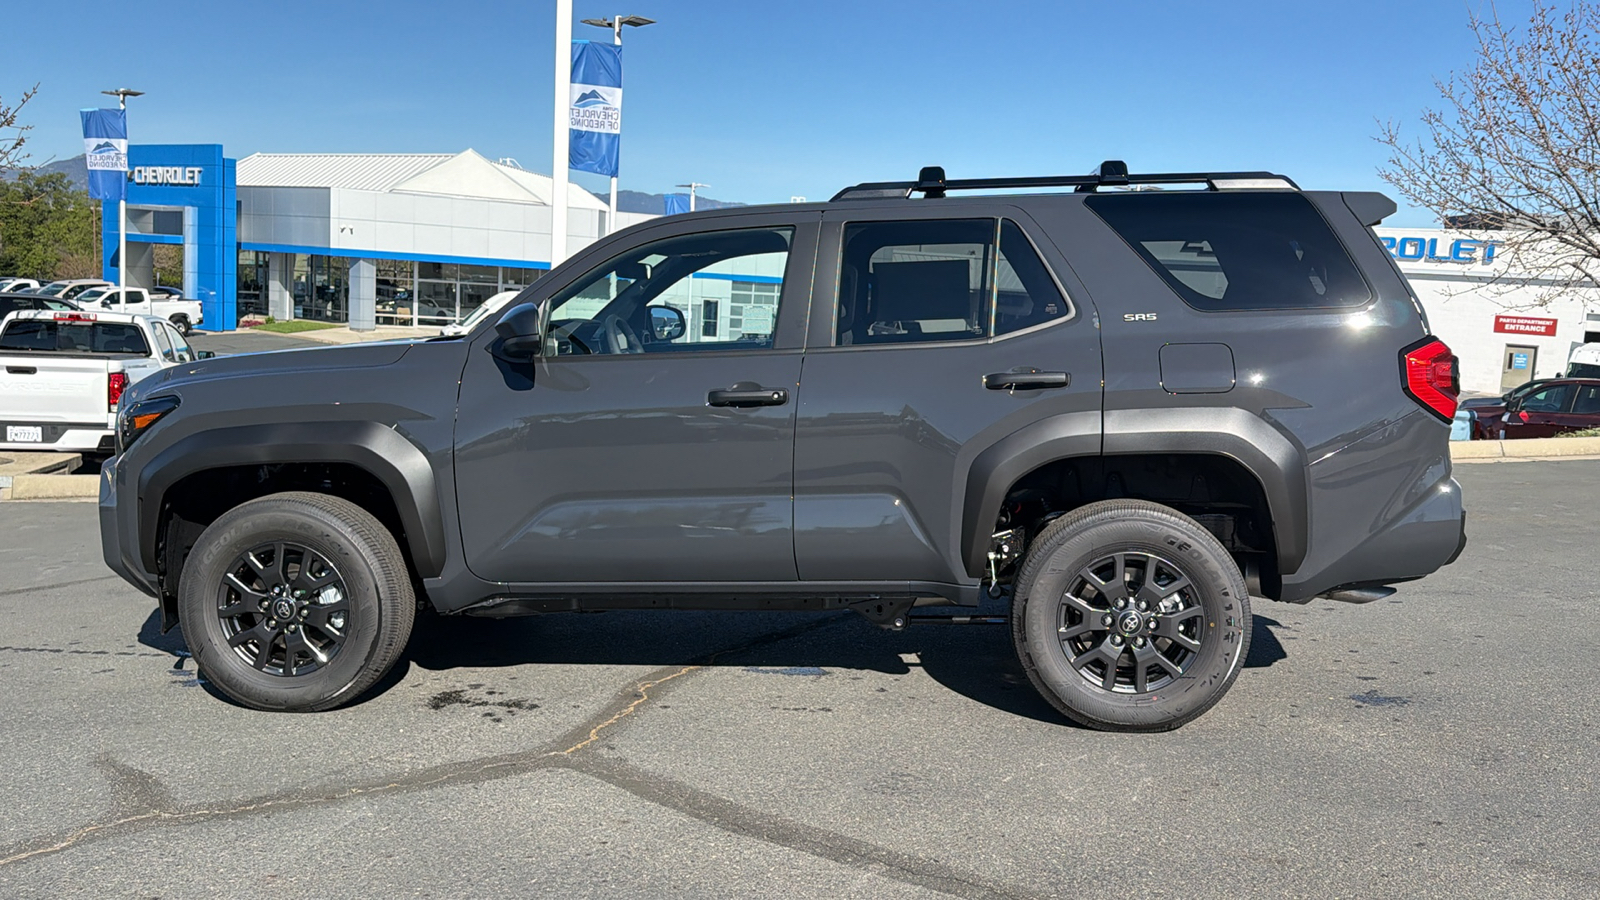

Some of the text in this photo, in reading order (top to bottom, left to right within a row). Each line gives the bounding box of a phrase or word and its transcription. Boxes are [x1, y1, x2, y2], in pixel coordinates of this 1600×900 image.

[134, 166, 202, 184] CHEVROLET
[1123, 313, 1157, 322] SR5
[1504, 324, 1546, 332] ENTRANCE
